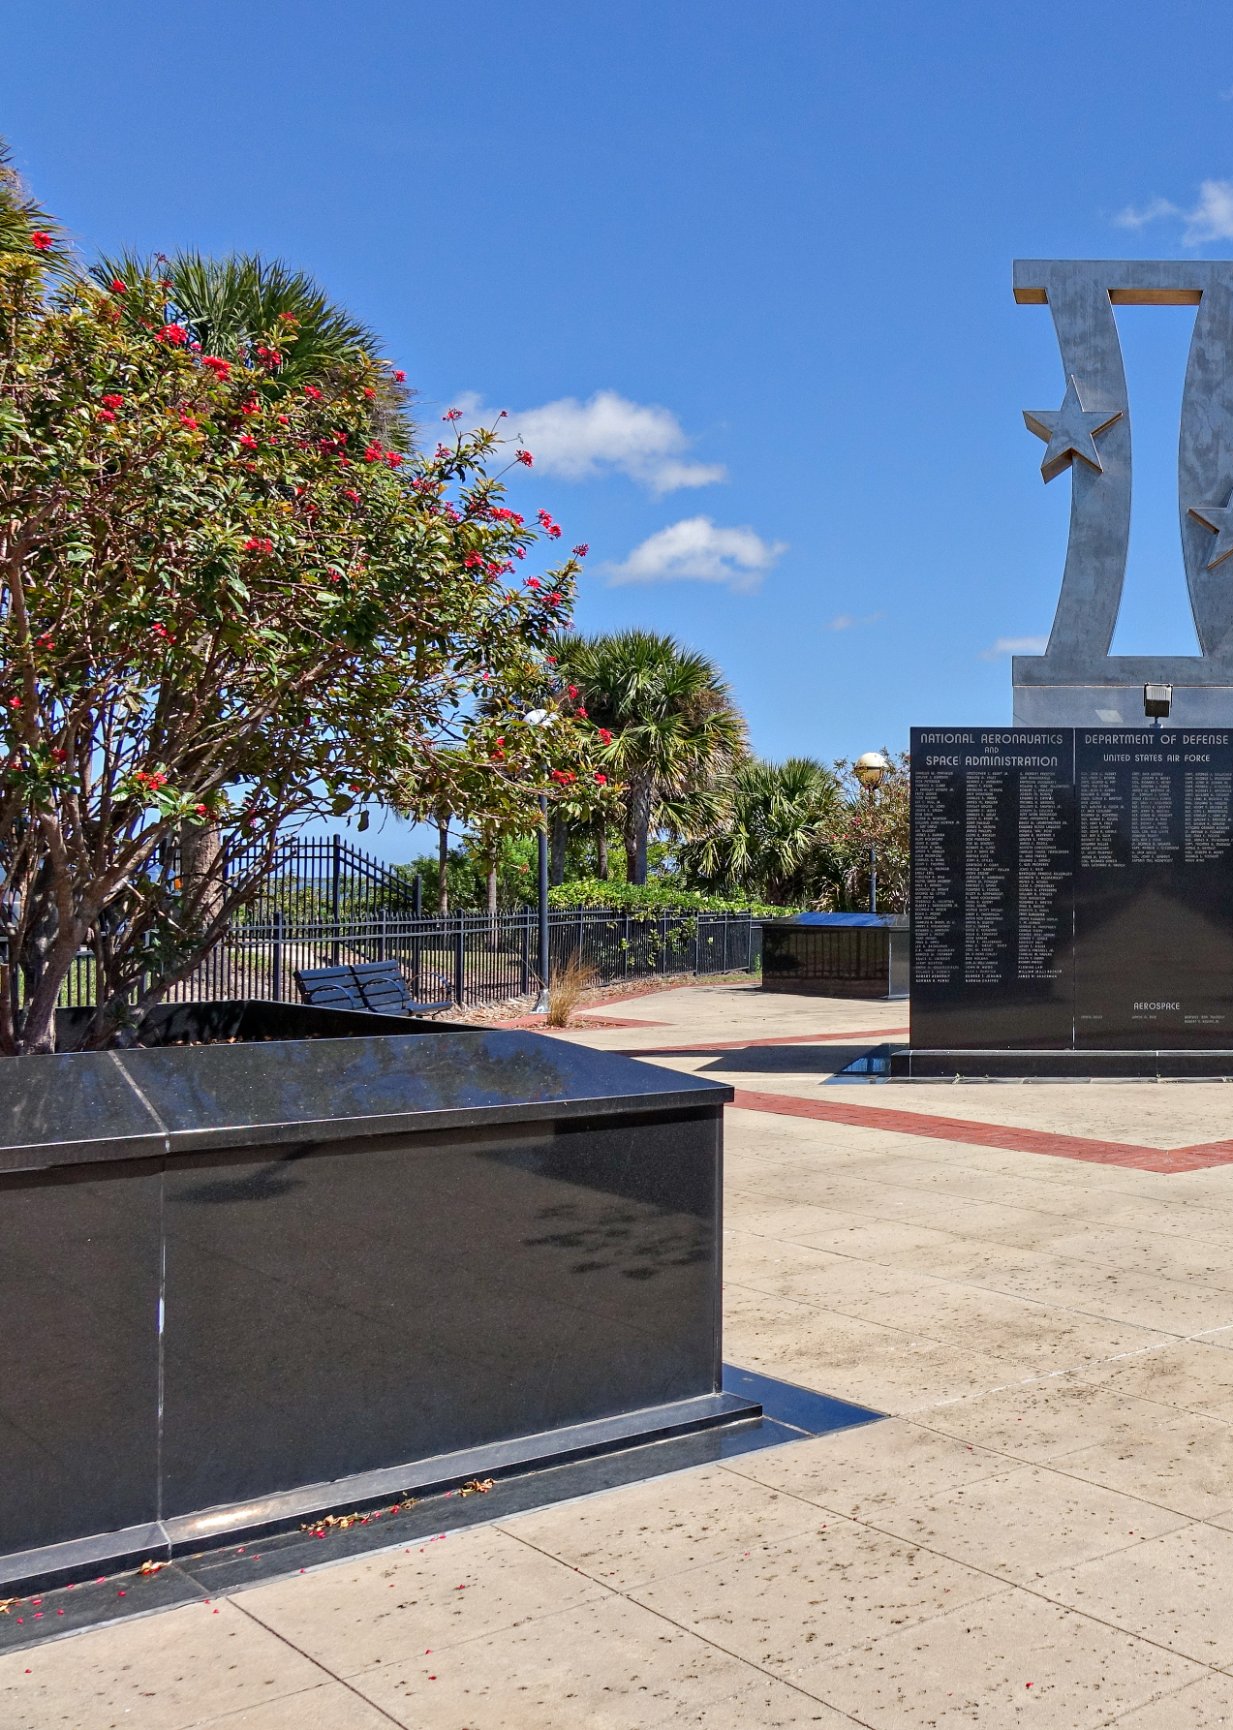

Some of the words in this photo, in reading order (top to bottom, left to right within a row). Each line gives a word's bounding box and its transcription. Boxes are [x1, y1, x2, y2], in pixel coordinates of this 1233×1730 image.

[920, 733, 975, 744] NATIONAL
[1085, 734, 1155, 745] DEPARTMENT
[1160, 734, 1177, 745] OF
[1182, 734, 1229, 745] DEFENSE
[984, 746, 1000, 754] AND
[925, 755, 959, 766] SPACE
[965, 756, 1058, 767] ADMINISTRATION
[1103, 754, 1131, 762] UNITED
[1134, 754, 1163, 762] STATES
[1166, 754, 1180, 763] AIR
[1184, 754, 1211, 762] FORCE
[1133, 1002, 1180, 1011] AEROSPACE
